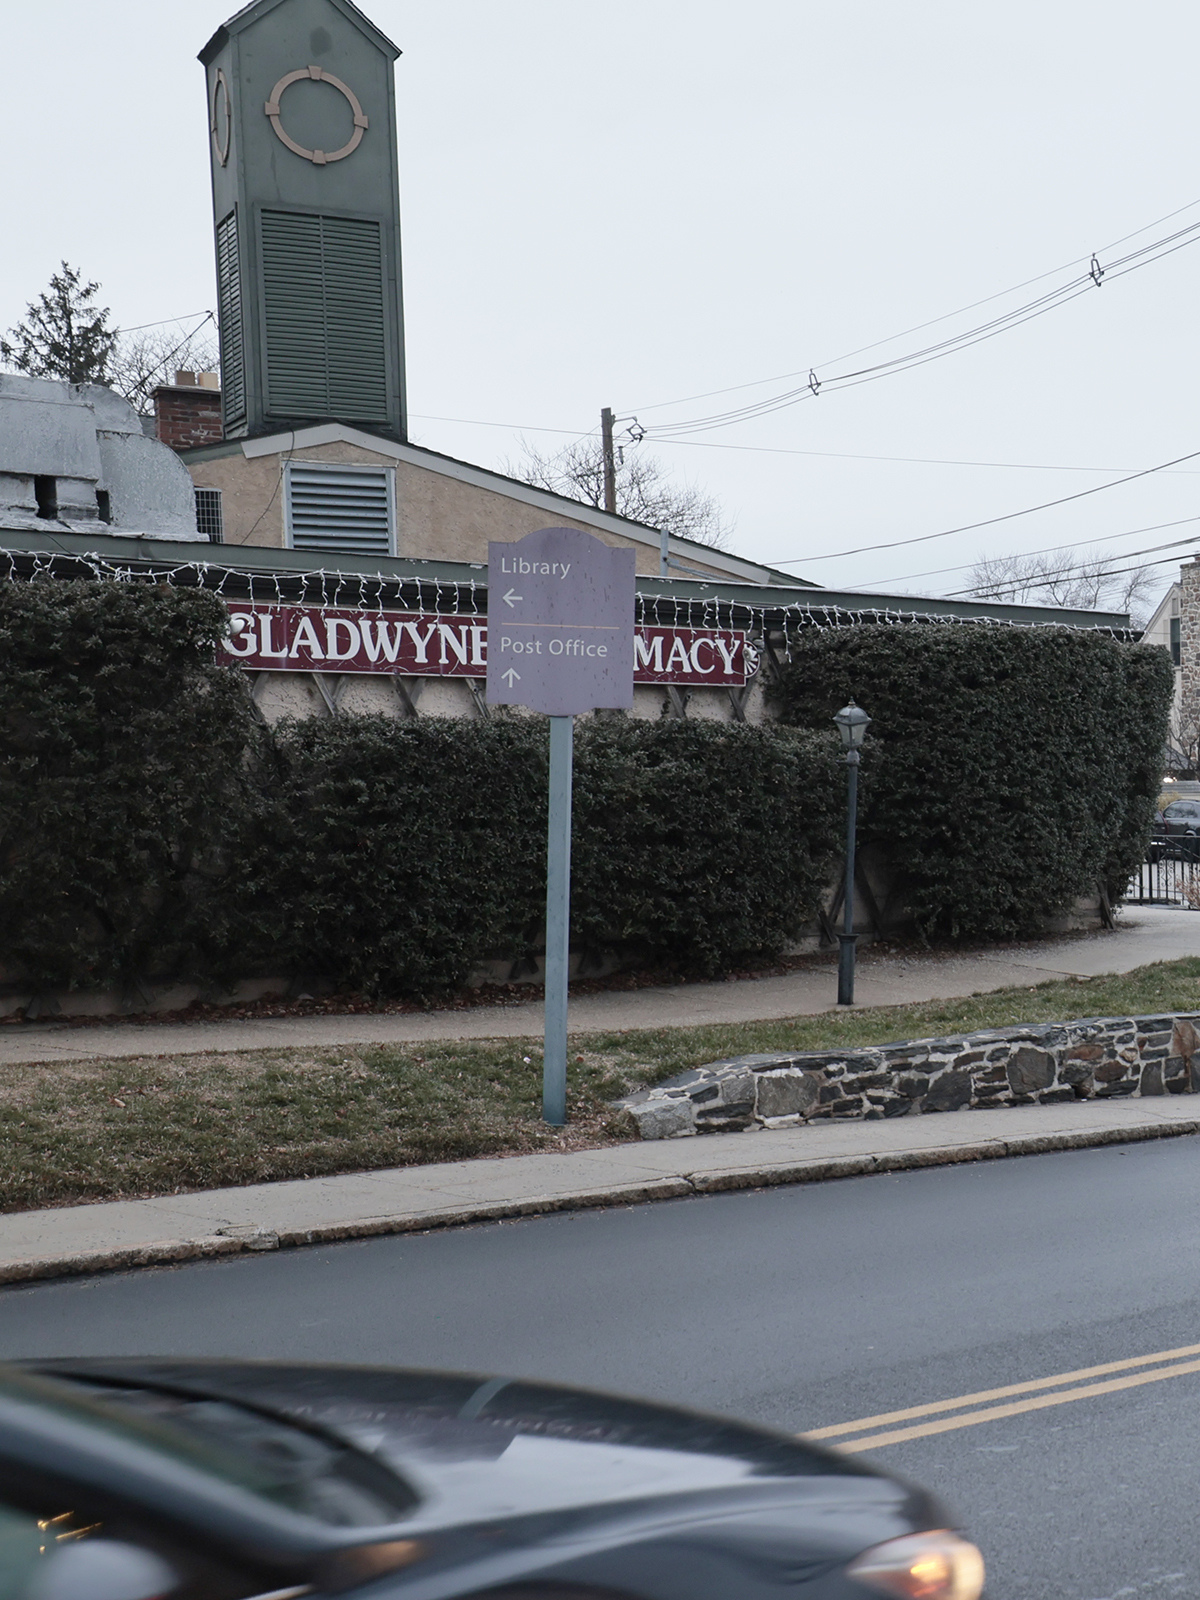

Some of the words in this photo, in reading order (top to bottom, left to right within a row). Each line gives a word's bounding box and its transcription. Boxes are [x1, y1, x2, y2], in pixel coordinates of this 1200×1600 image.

[501, 557, 571, 579] Library
[501, 637, 542, 655] Post
[549, 638, 608, 658] Office
[633, 634, 740, 675] MACY
